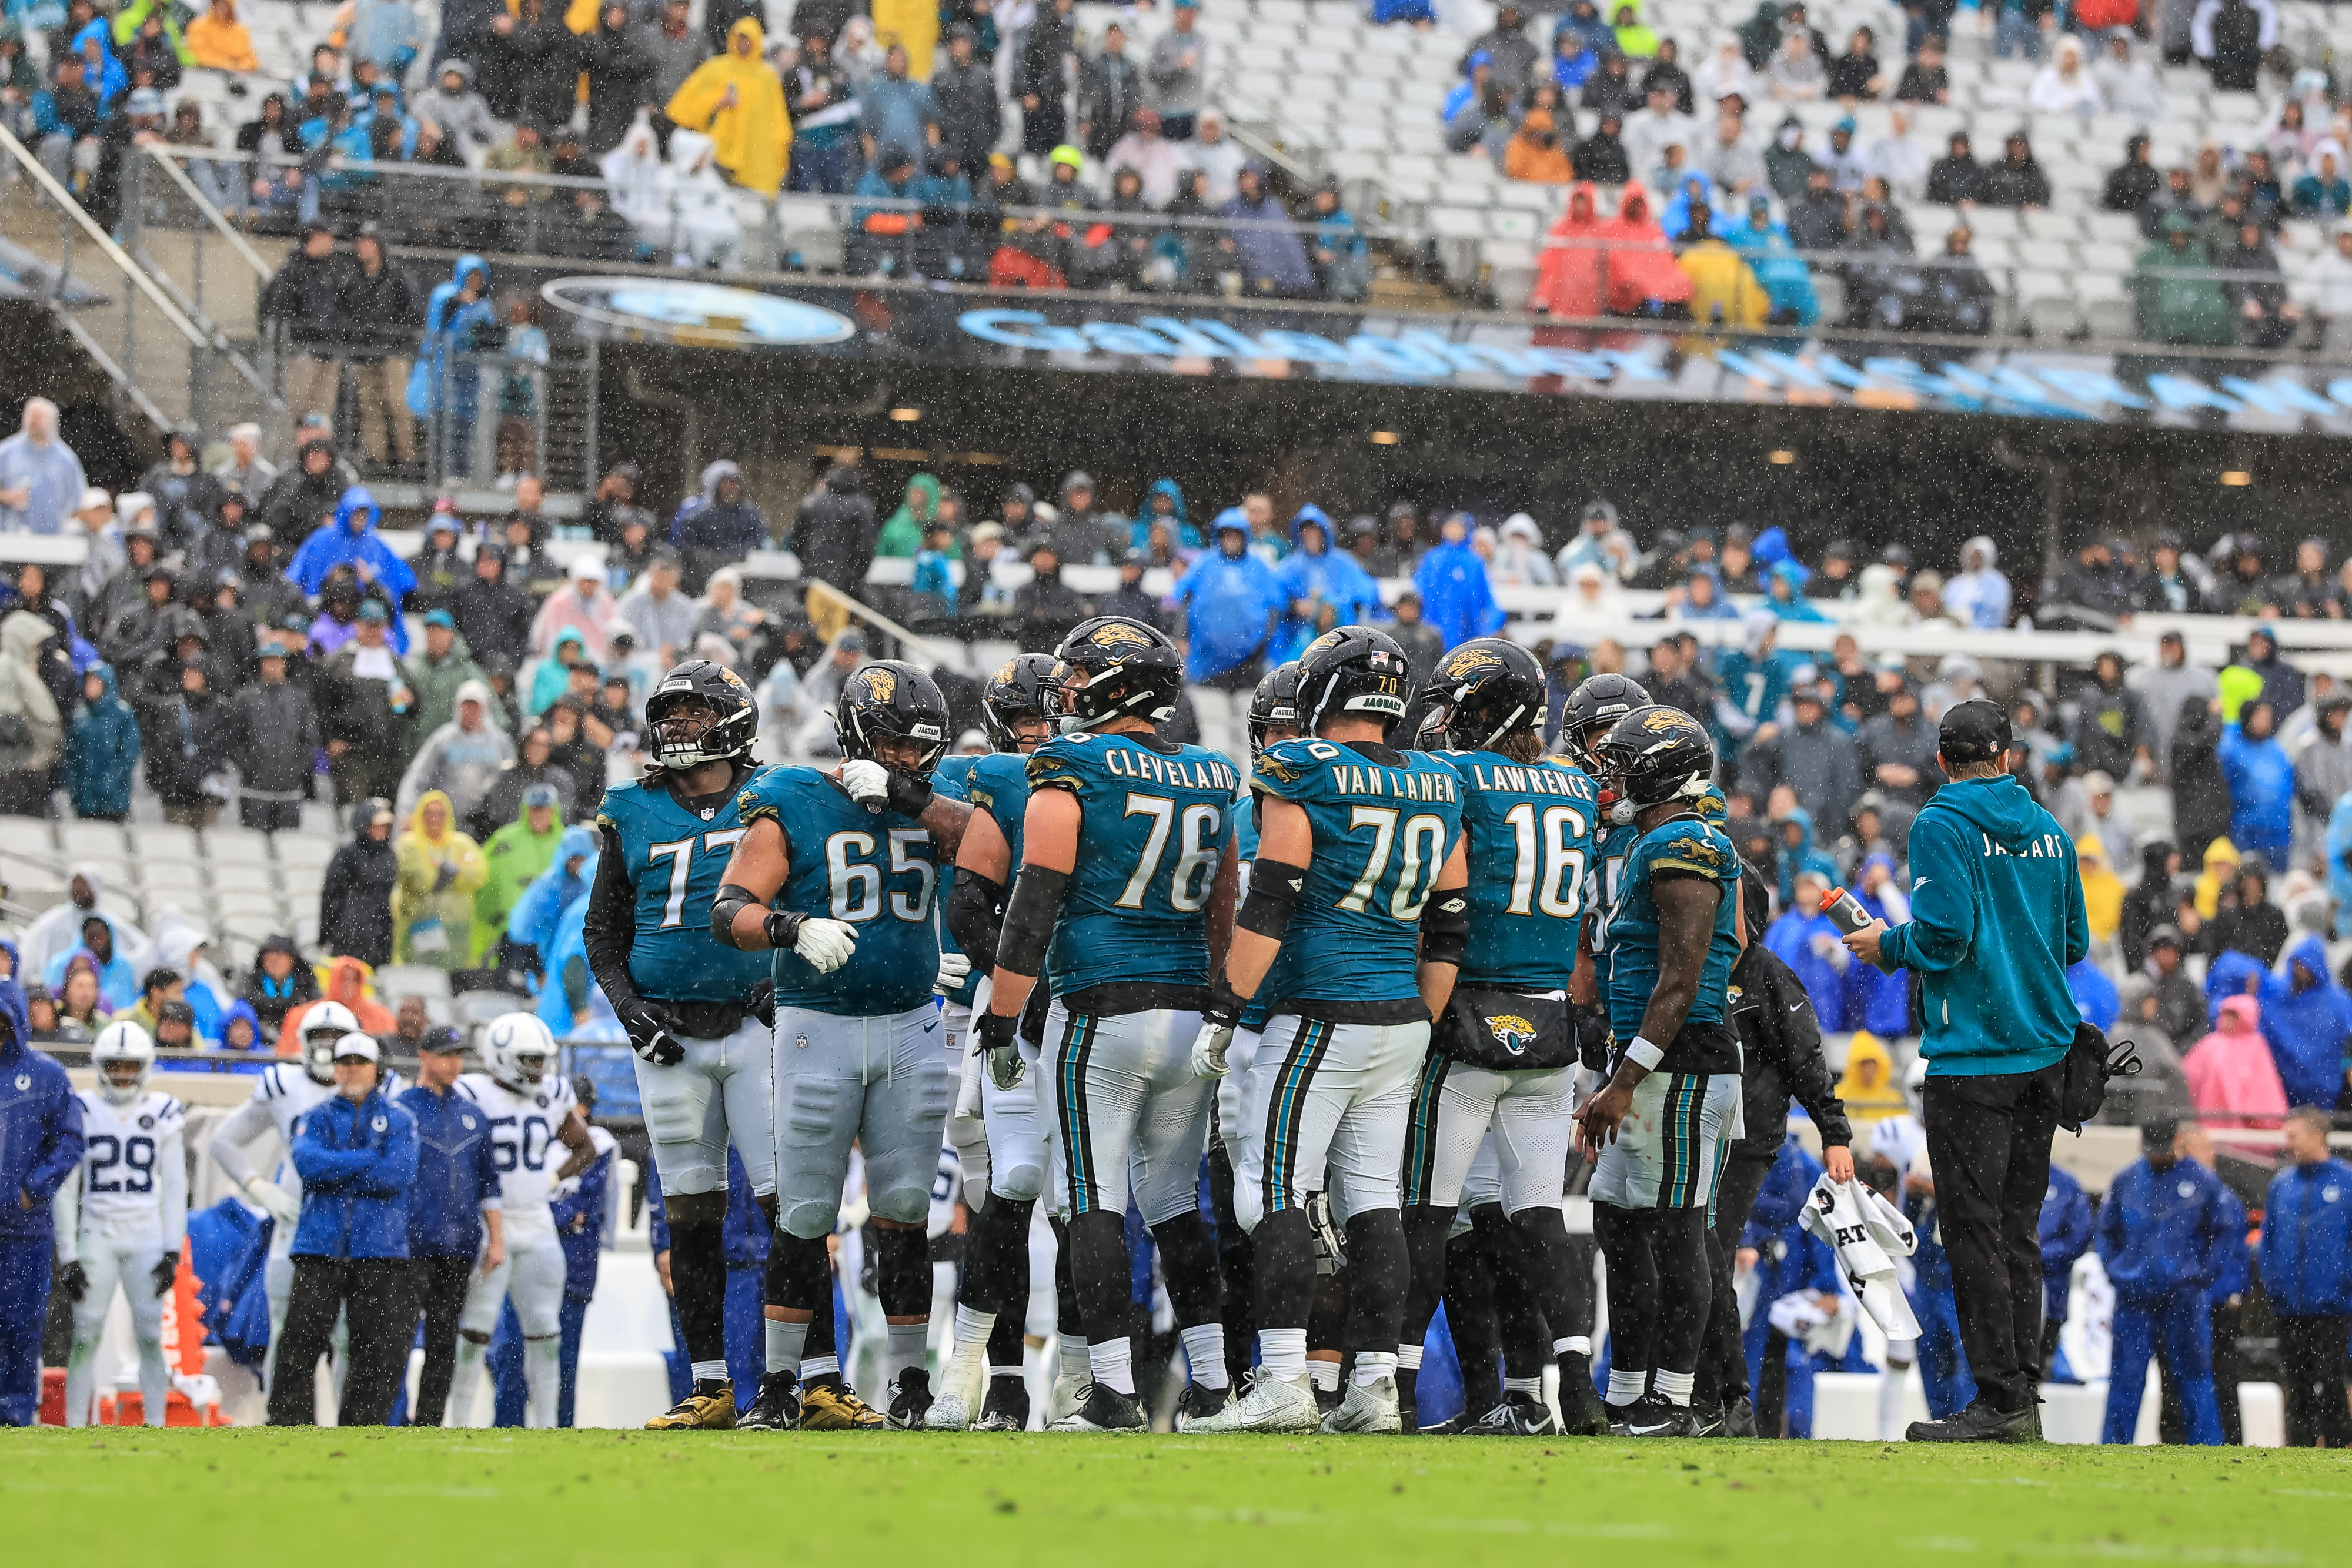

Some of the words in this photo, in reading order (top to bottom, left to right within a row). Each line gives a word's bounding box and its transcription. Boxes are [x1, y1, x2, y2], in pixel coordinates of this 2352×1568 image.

[1363, 698, 1401, 712] JAGUARS
[1379, 676, 1397, 694] 70
[1744, 671, 1769, 714] 7
[1601, 705, 1626, 713] JAGUARS
[918, 726, 939, 736] JAGUARS
[1105, 748, 1234, 791] CLEVELAND
[1332, 765, 1382, 797] VAN
[1392, 771, 1456, 804] LANEN
[1472, 764, 1593, 803] LAWRENCE
[1114, 793, 1221, 912] 76
[1335, 804, 1447, 922] 70
[1504, 803, 1586, 918] 16
[825, 827, 939, 922] 65
[88, 1135, 155, 1193] 29
[490, 1116, 554, 1172] 50
